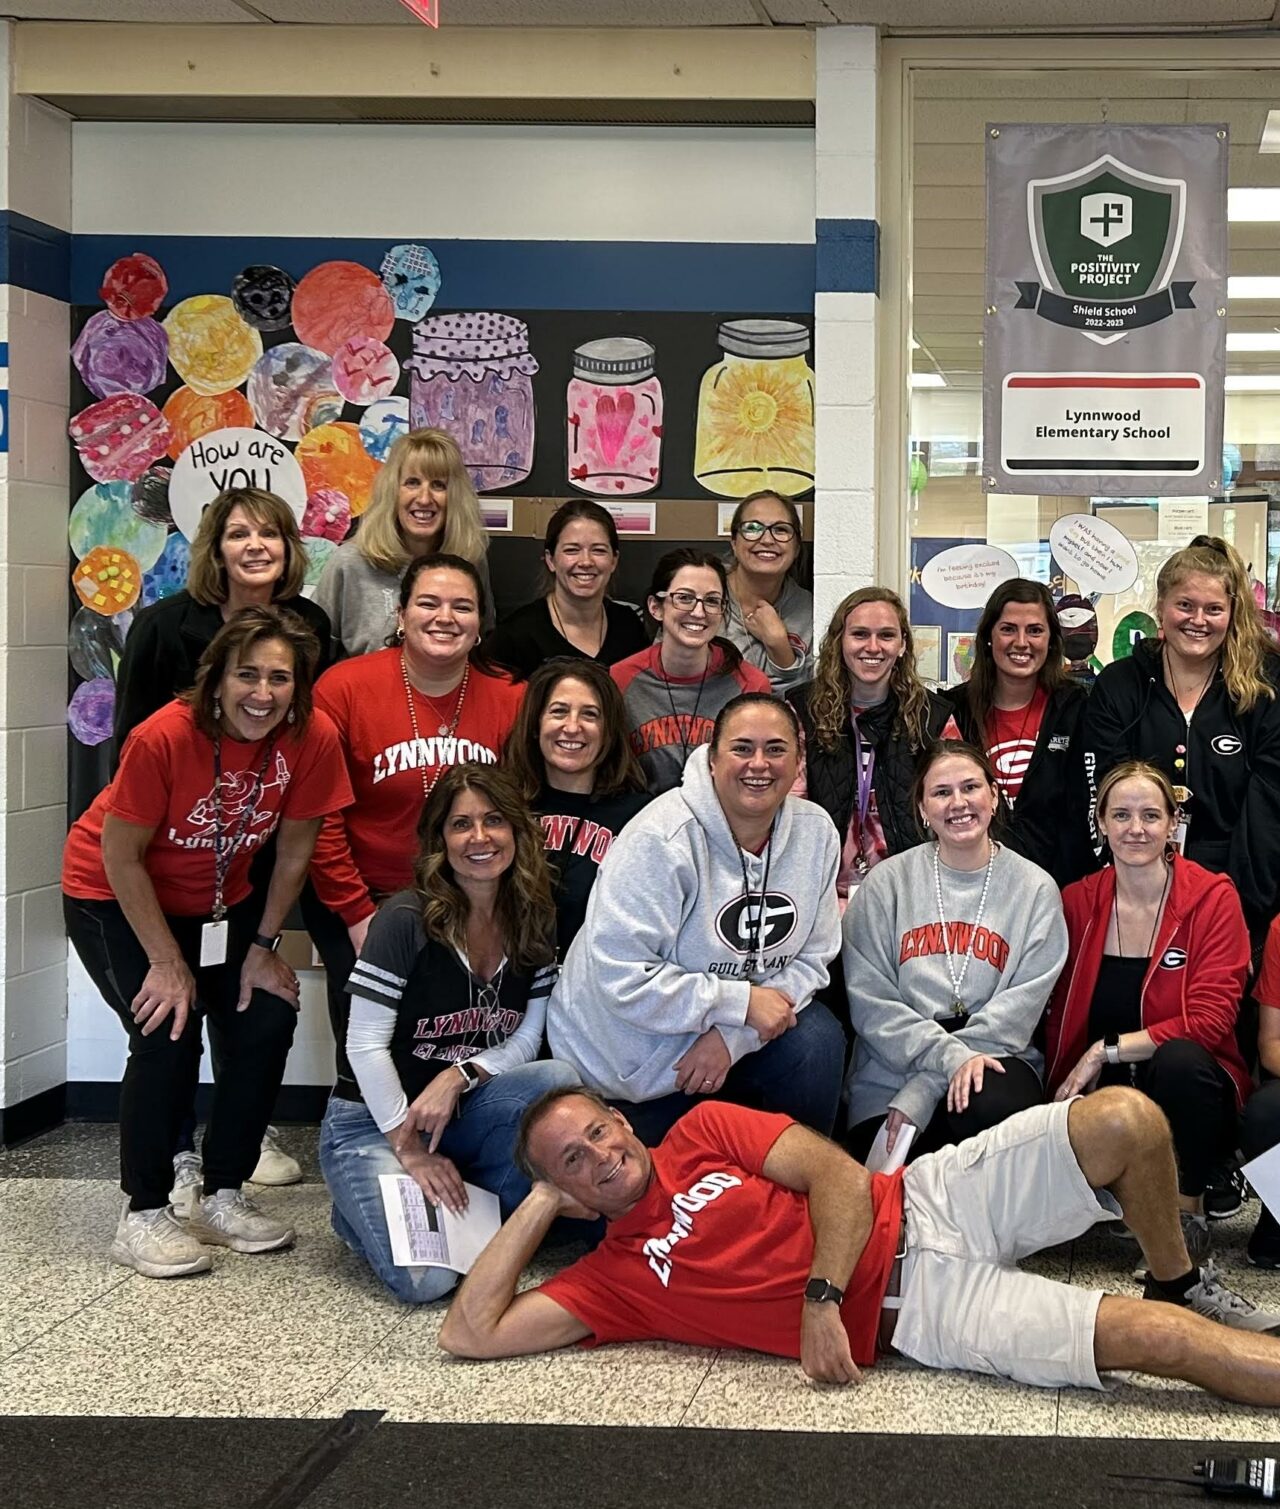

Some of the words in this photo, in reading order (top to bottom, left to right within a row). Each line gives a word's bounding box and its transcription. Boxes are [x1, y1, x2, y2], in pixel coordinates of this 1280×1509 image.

[1097, 254, 1113, 262] THE
[1071, 263, 1141, 274] POSITIVITY
[1079, 274, 1131, 287] PROJECT
[1072, 304, 1103, 316] Shield
[1104, 304, 1137, 317] School
[1085, 318, 1124, 327] 2022-2023
[1065, 409, 1141, 424] Lynnwood
[1035, 426, 1119, 441] Elementary
[1122, 426, 1171, 439] School
[190, 440, 239, 469] How
[248, 441, 284, 465] are
[209, 467, 271, 492] YOU
